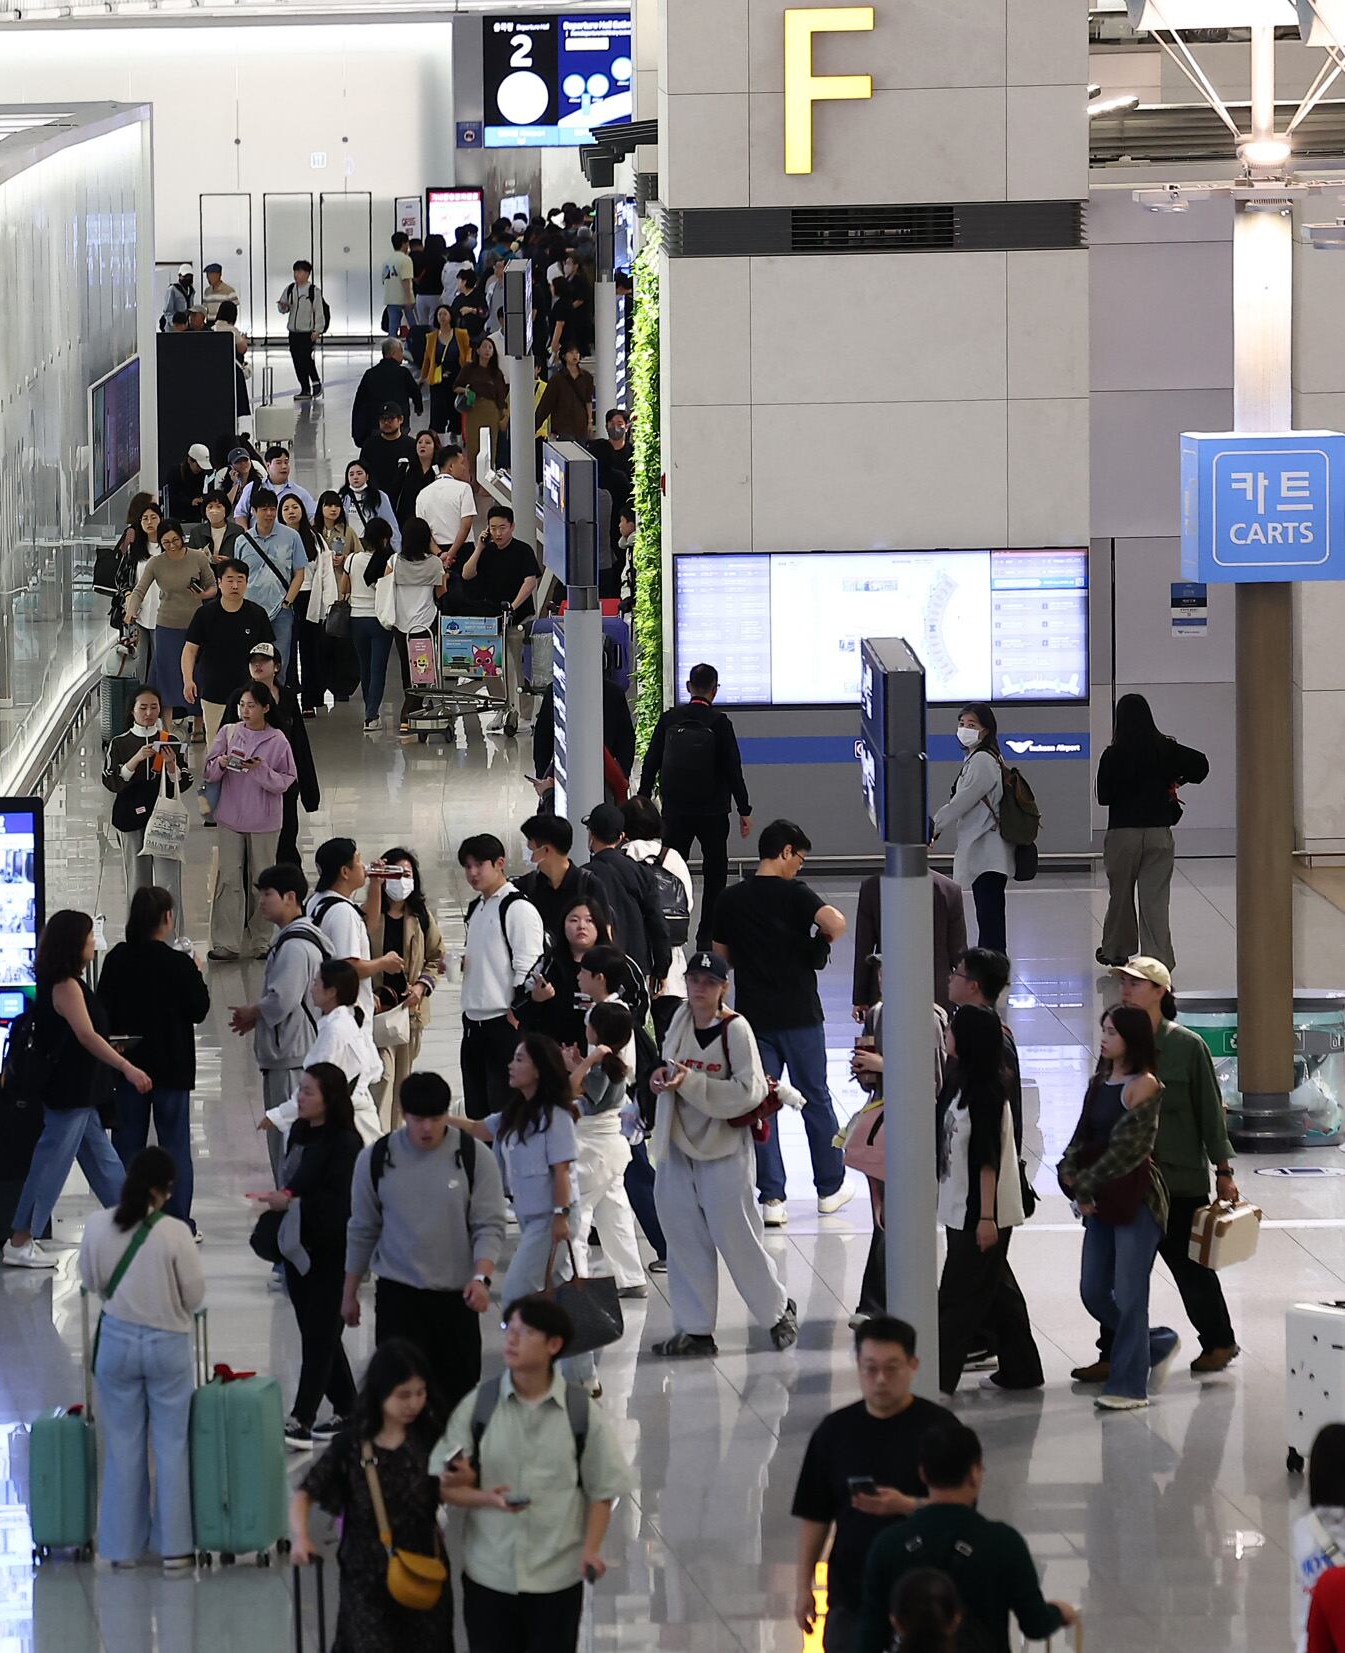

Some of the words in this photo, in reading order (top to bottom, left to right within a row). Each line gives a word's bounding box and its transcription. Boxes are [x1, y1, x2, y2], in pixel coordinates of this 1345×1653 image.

[510, 34, 533, 68] 2
[783, 7, 875, 175] F
[1230, 472, 1314, 514] 카트
[1230, 523, 1314, 545] CARTS
